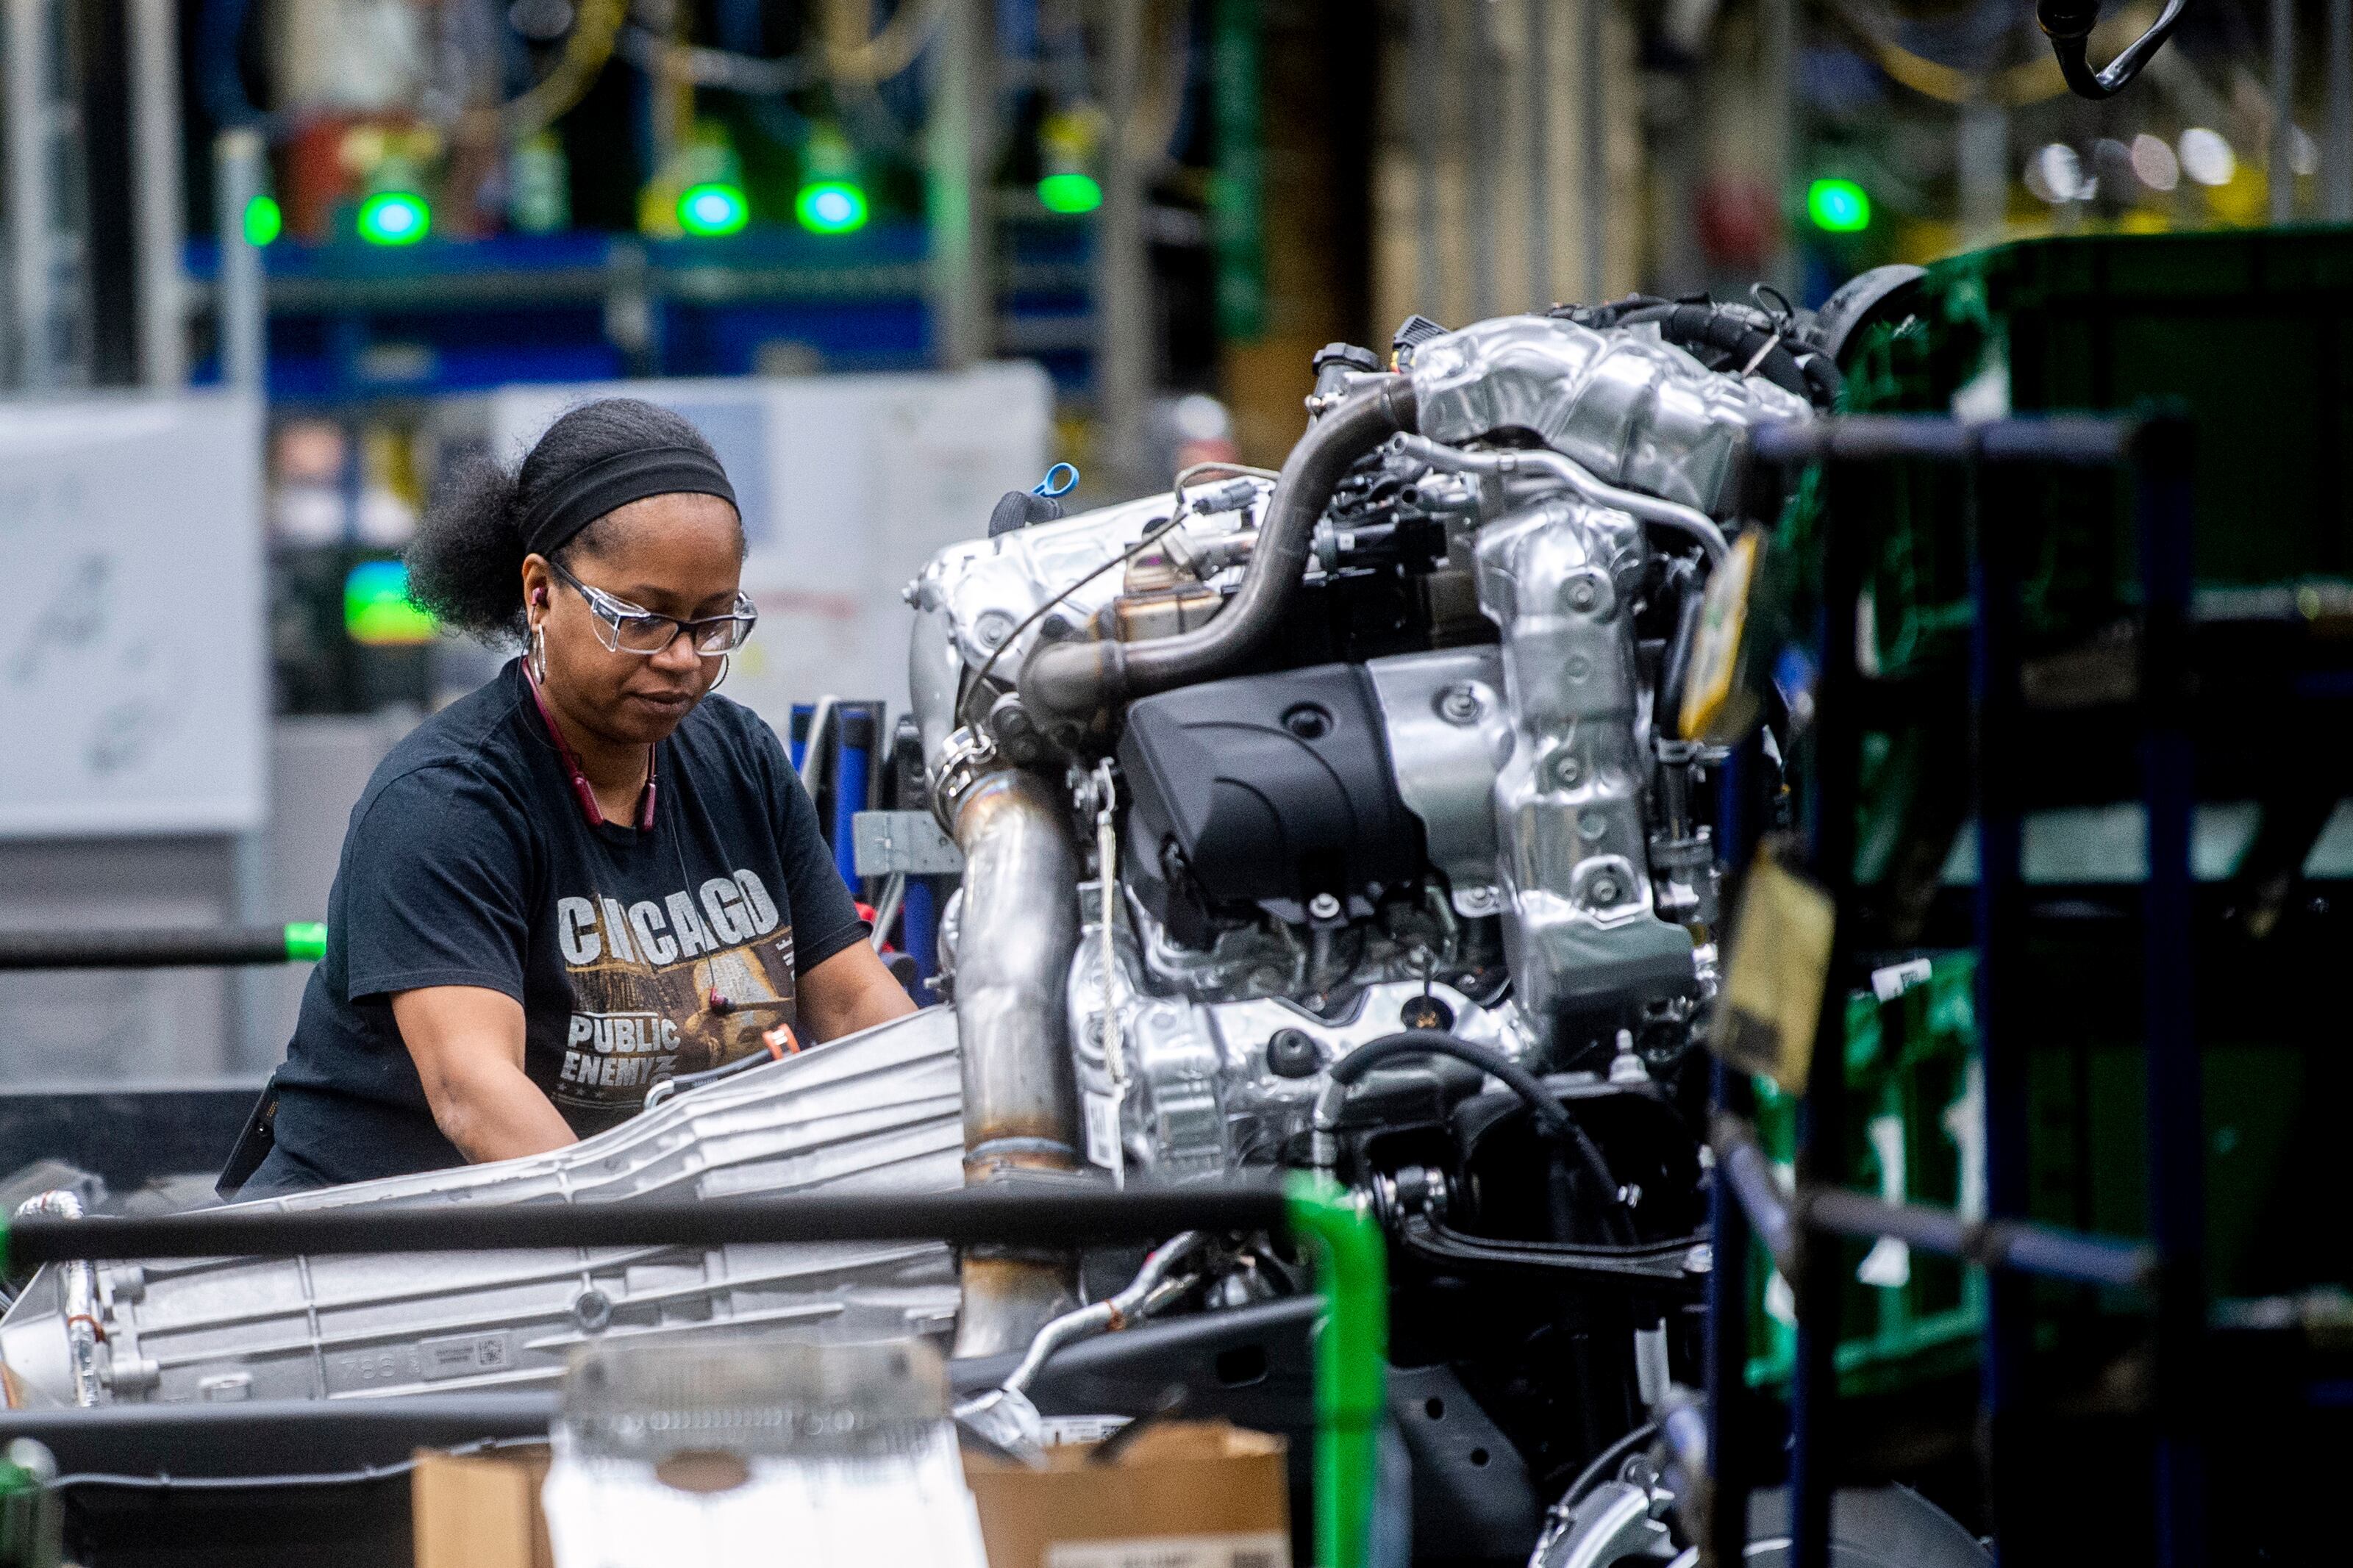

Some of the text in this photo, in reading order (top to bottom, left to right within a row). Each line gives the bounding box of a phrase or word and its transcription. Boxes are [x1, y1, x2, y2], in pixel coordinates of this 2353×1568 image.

[557, 869, 779, 965] CICAGO
[567, 1014, 681, 1053] PUBLIC
[560, 1051, 654, 1086] ENEMY
